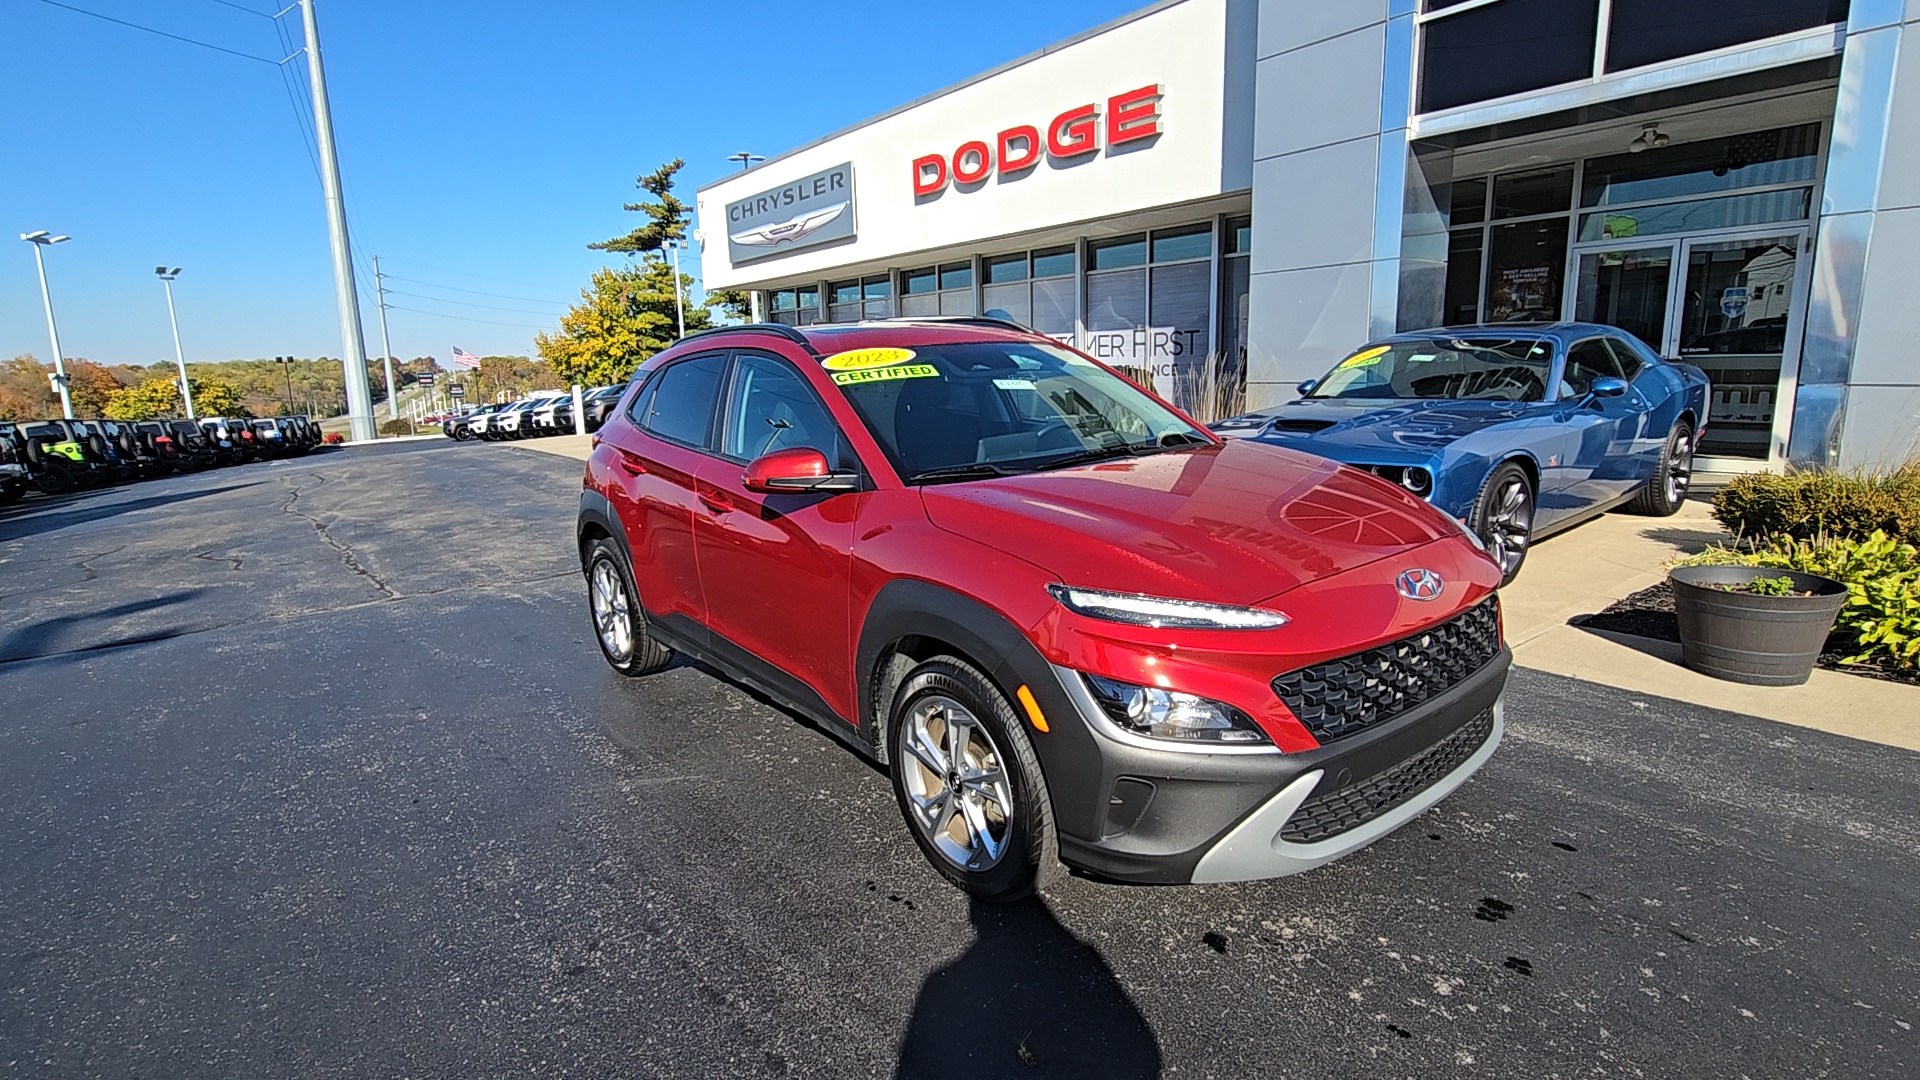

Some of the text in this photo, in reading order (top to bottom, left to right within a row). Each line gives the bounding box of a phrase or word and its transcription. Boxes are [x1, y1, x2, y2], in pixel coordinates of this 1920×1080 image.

[912, 83, 1163, 196] DODGE
[729, 171, 845, 222] CHRYSLER
[836, 366, 932, 383] CERTIFIED
[841, 350, 900, 368] 2023
